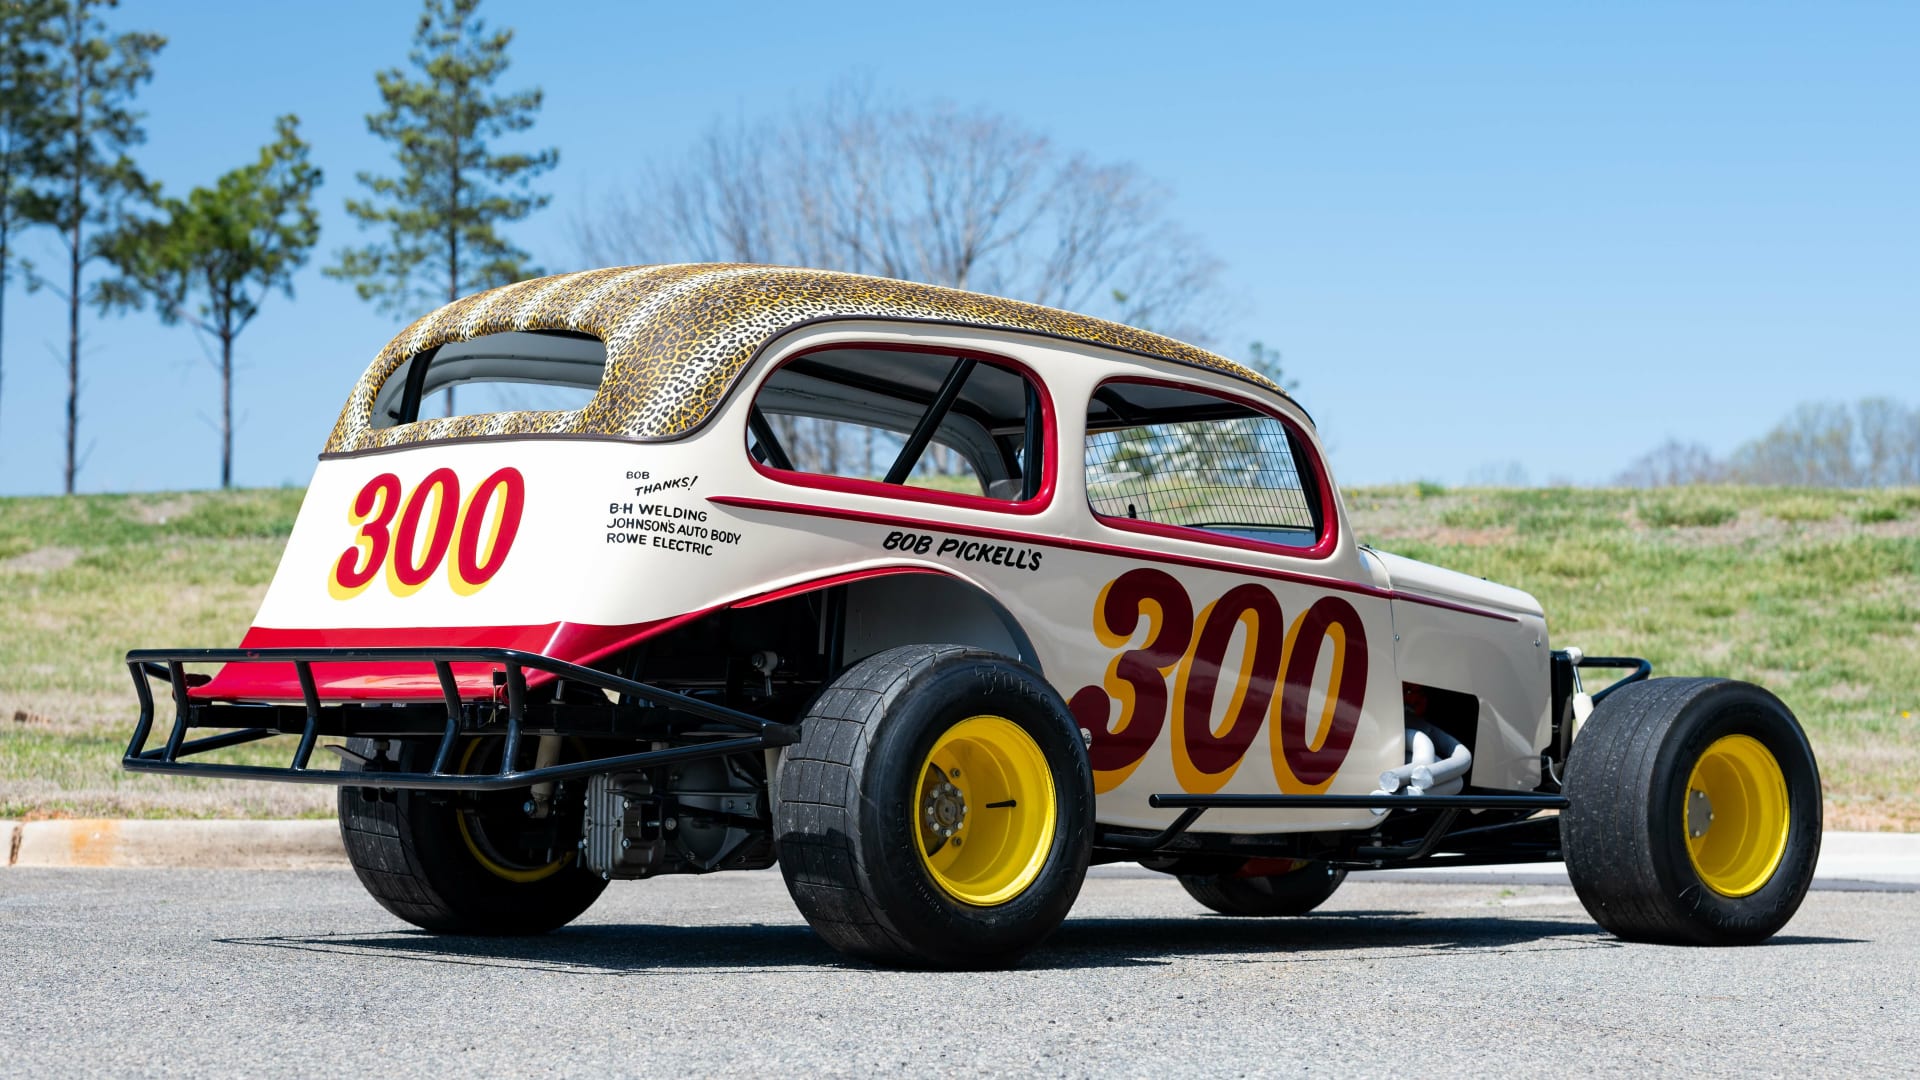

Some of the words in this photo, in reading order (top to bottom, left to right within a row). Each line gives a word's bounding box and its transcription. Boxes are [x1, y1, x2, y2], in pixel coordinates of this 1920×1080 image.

[626, 471, 650, 479] BOB
[635, 475, 699, 497] THANKS!
[609, 503, 633, 514] B-H
[639, 503, 708, 522] WELDING
[327, 466, 525, 601] 300
[606, 518, 675, 534] JOHNSON'S
[677, 524, 708, 539] AUTO
[711, 529, 742, 545] BODY
[606, 532, 648, 545] ROWE
[653, 536, 714, 556] ELECTRIC
[882, 531, 933, 555] BOB
[936, 538, 1043, 571] PICKELL'S
[1066, 568, 1369, 795] 300
